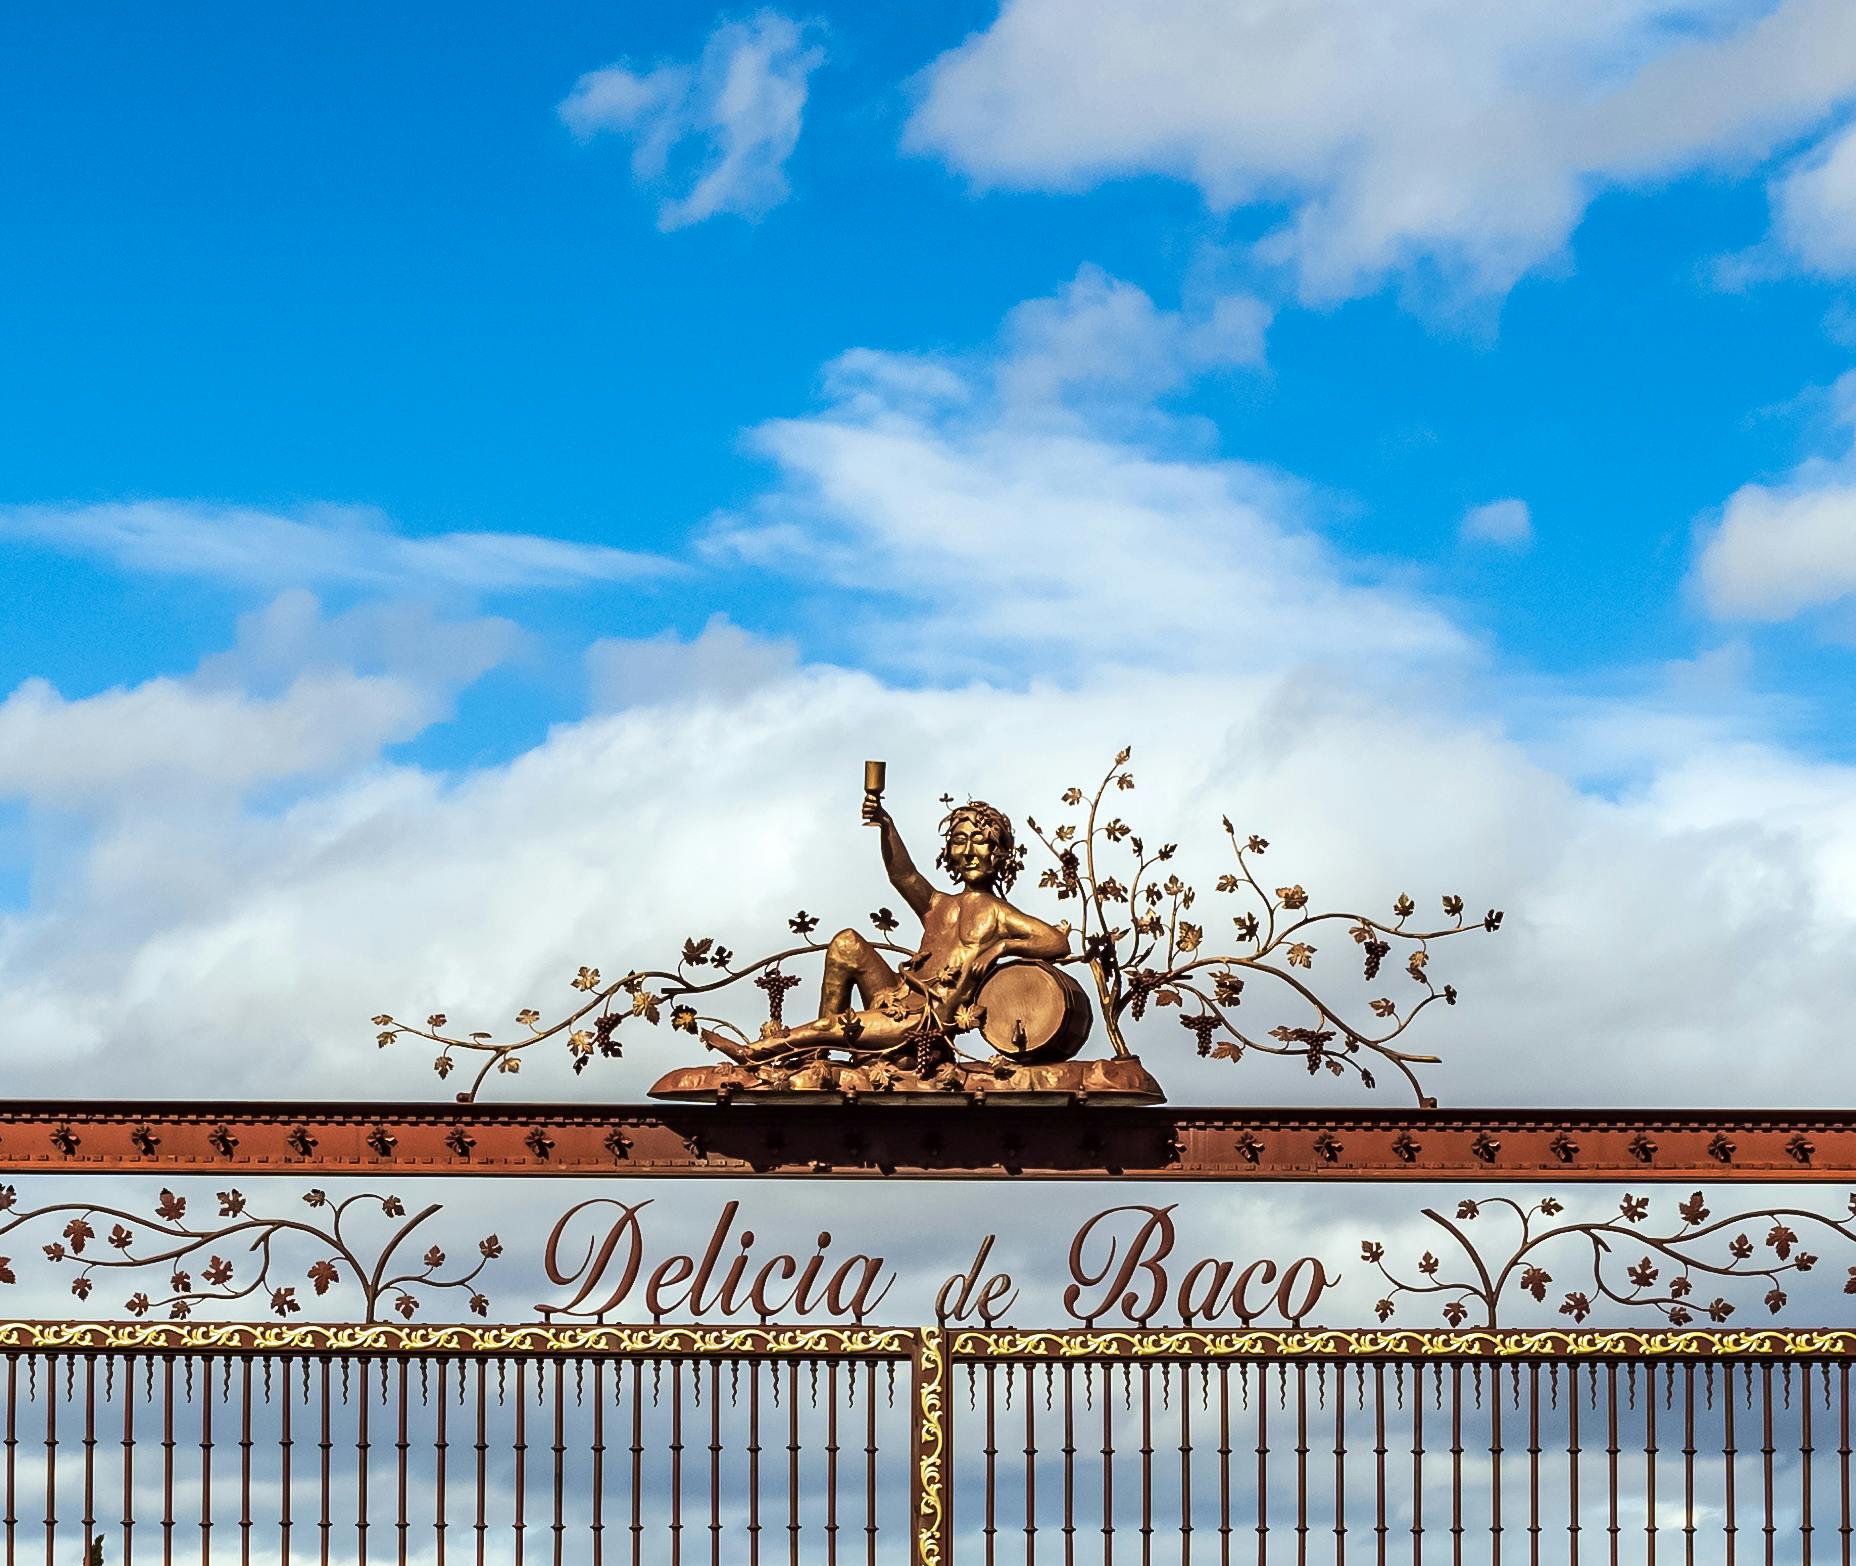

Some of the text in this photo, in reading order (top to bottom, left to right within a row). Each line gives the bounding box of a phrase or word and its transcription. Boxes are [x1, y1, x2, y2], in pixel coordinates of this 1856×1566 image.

[533, 1198, 1343, 1322] Delicia de Baco
